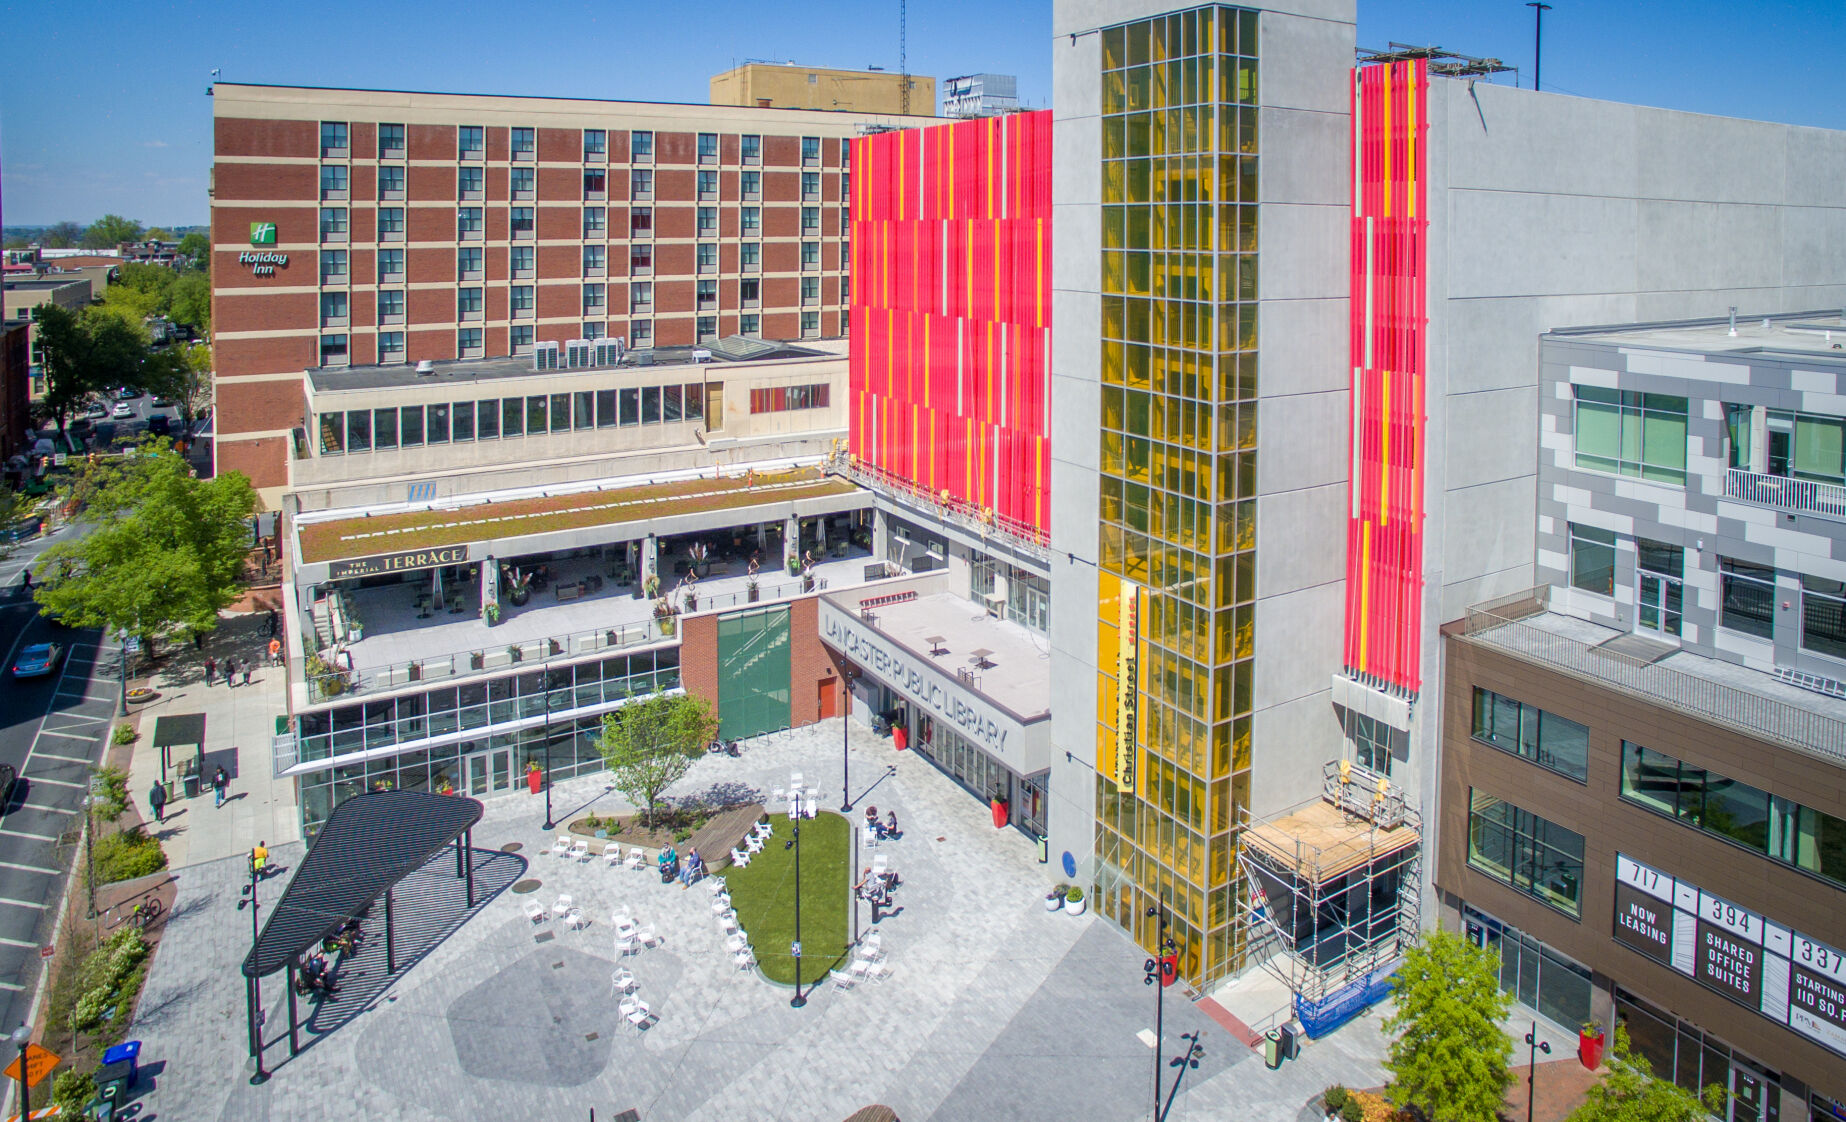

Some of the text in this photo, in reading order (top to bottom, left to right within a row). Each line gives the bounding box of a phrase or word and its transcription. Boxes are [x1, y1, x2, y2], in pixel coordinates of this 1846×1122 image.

[239, 251, 288, 265] Holiday
[253, 263, 274, 274] Inn
[349, 561, 367, 569] THE
[383, 549, 461, 570] TERRACE
[825, 614, 1008, 753] LANCASTER PUBLIC LIBRARY
[1123, 656, 1136, 708] Street
[1122, 713, 1134, 786] Christian
[1619, 913, 1667, 945] LEASING
[1630, 903, 1656, 925] NOW
[1632, 863, 1659, 890] 717
[1712, 900, 1750, 933] 394
[1801, 940, 1843, 974] 337
[1706, 932, 1755, 964] SHARED
[1707, 963, 1751, 993] SUITES
[1708, 949, 1751, 979] OFFICE
[1796, 973, 1845, 1004] STARTING
[1797, 988, 1815, 1006] 110
[1818, 996, 1839, 1019] SQ.
